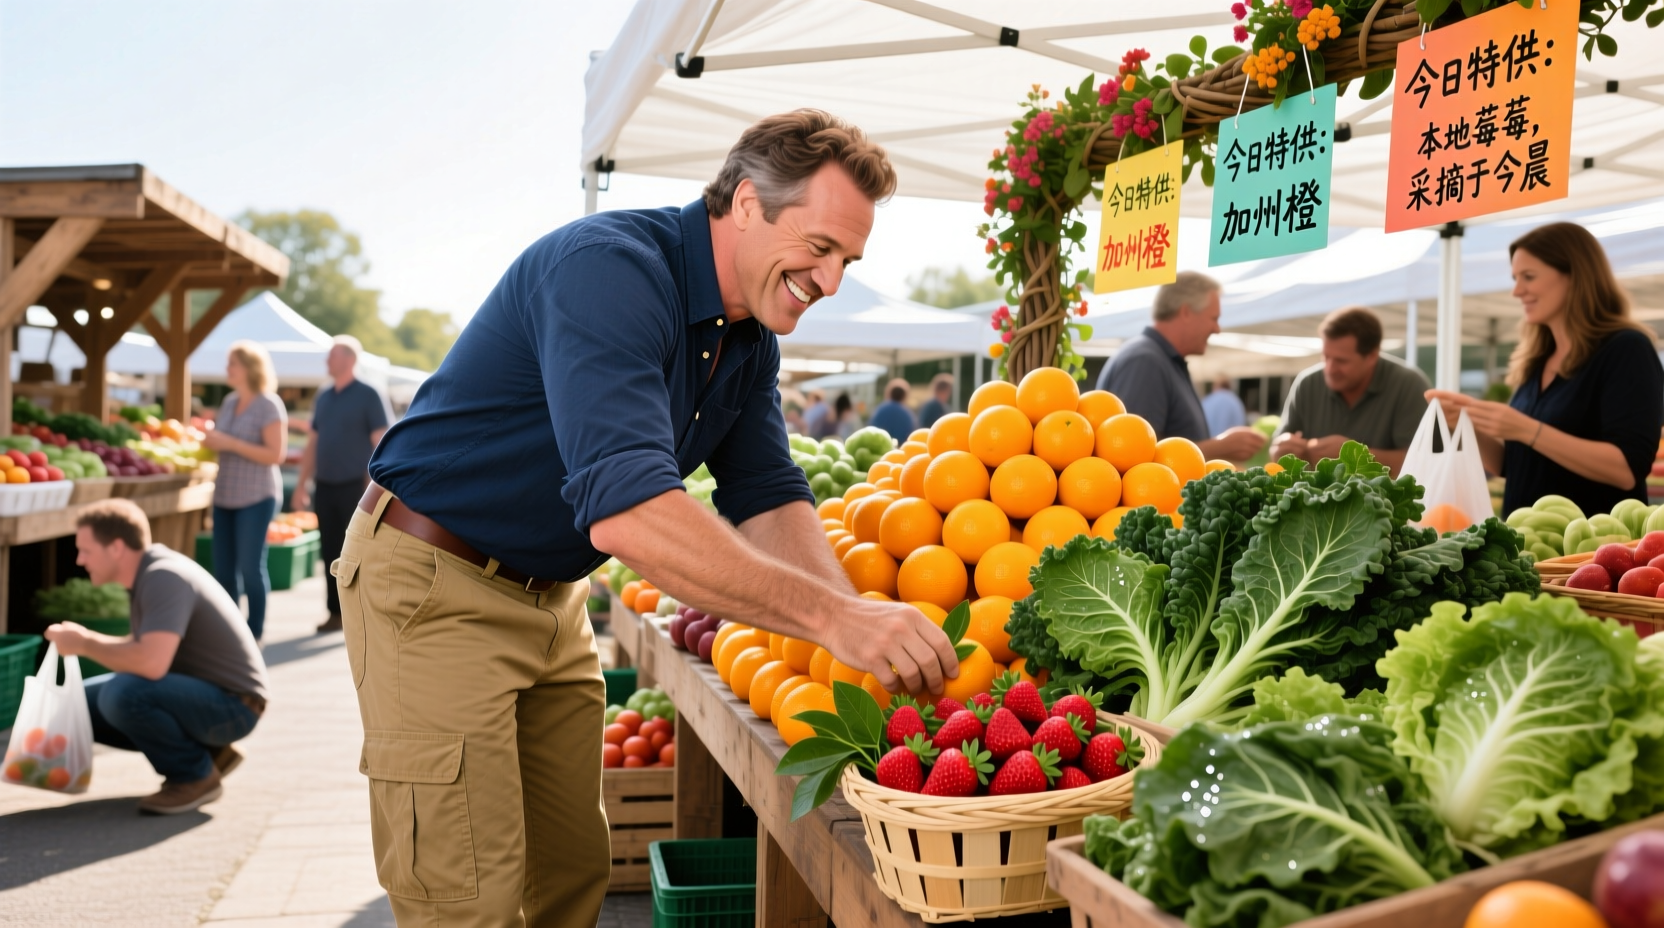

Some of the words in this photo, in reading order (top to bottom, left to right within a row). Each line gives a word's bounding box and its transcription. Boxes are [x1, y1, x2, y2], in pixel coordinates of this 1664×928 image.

[1406, 139, 1551, 211] 采摘于今晨
[1219, 178, 1323, 245] 加州橙
[1102, 223, 1171, 272] 加州橙
